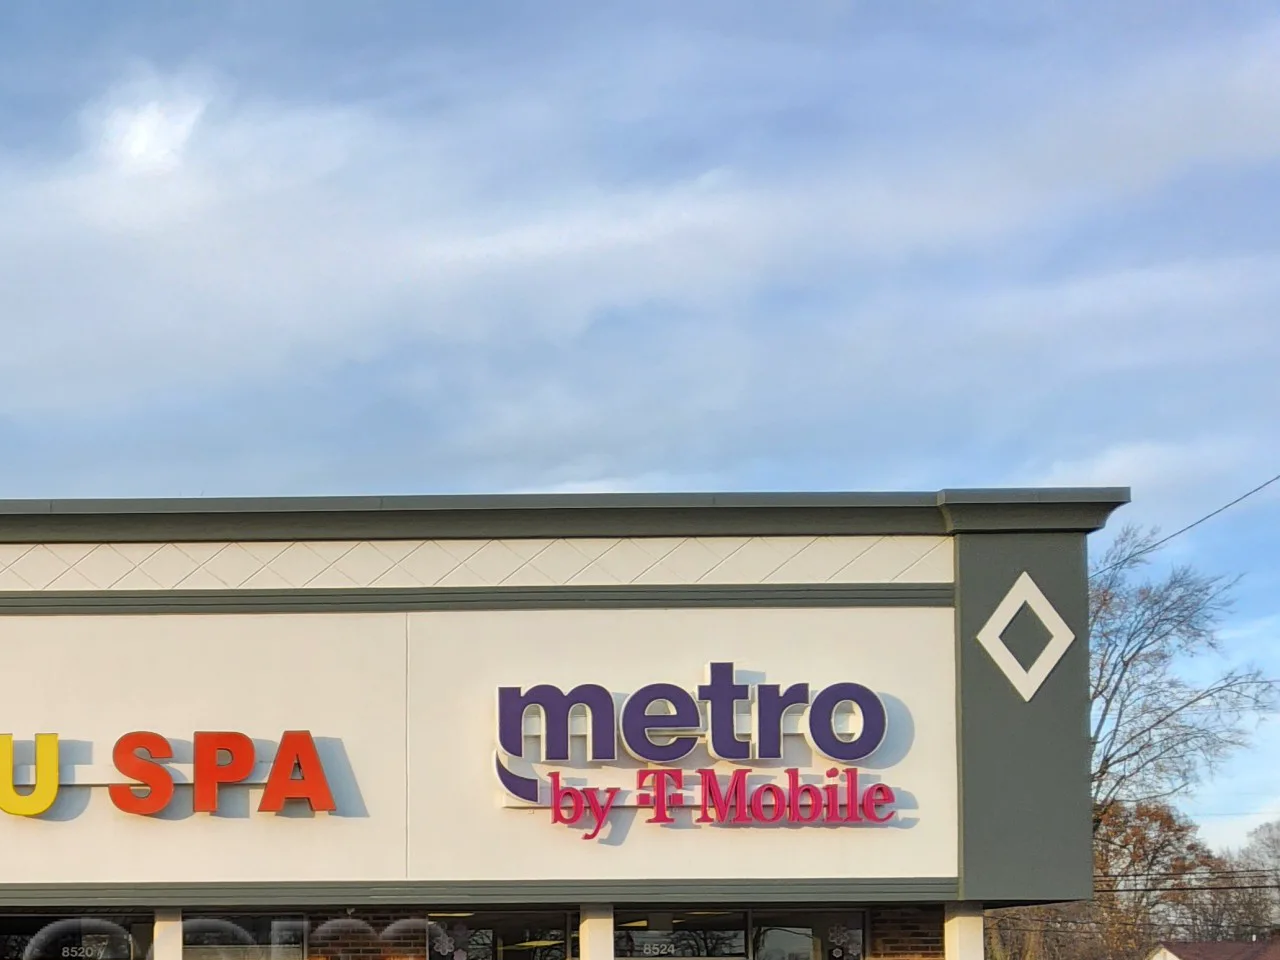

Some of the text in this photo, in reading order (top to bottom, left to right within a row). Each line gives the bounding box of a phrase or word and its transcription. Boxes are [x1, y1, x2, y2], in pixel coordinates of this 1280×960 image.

[496, 661, 887, 764] metro
[108, 729, 337, 816] SPA
[548, 770, 621, 840] by
[61, 946, 94, 958] 8520
[643, 943, 675, 956] 8524
